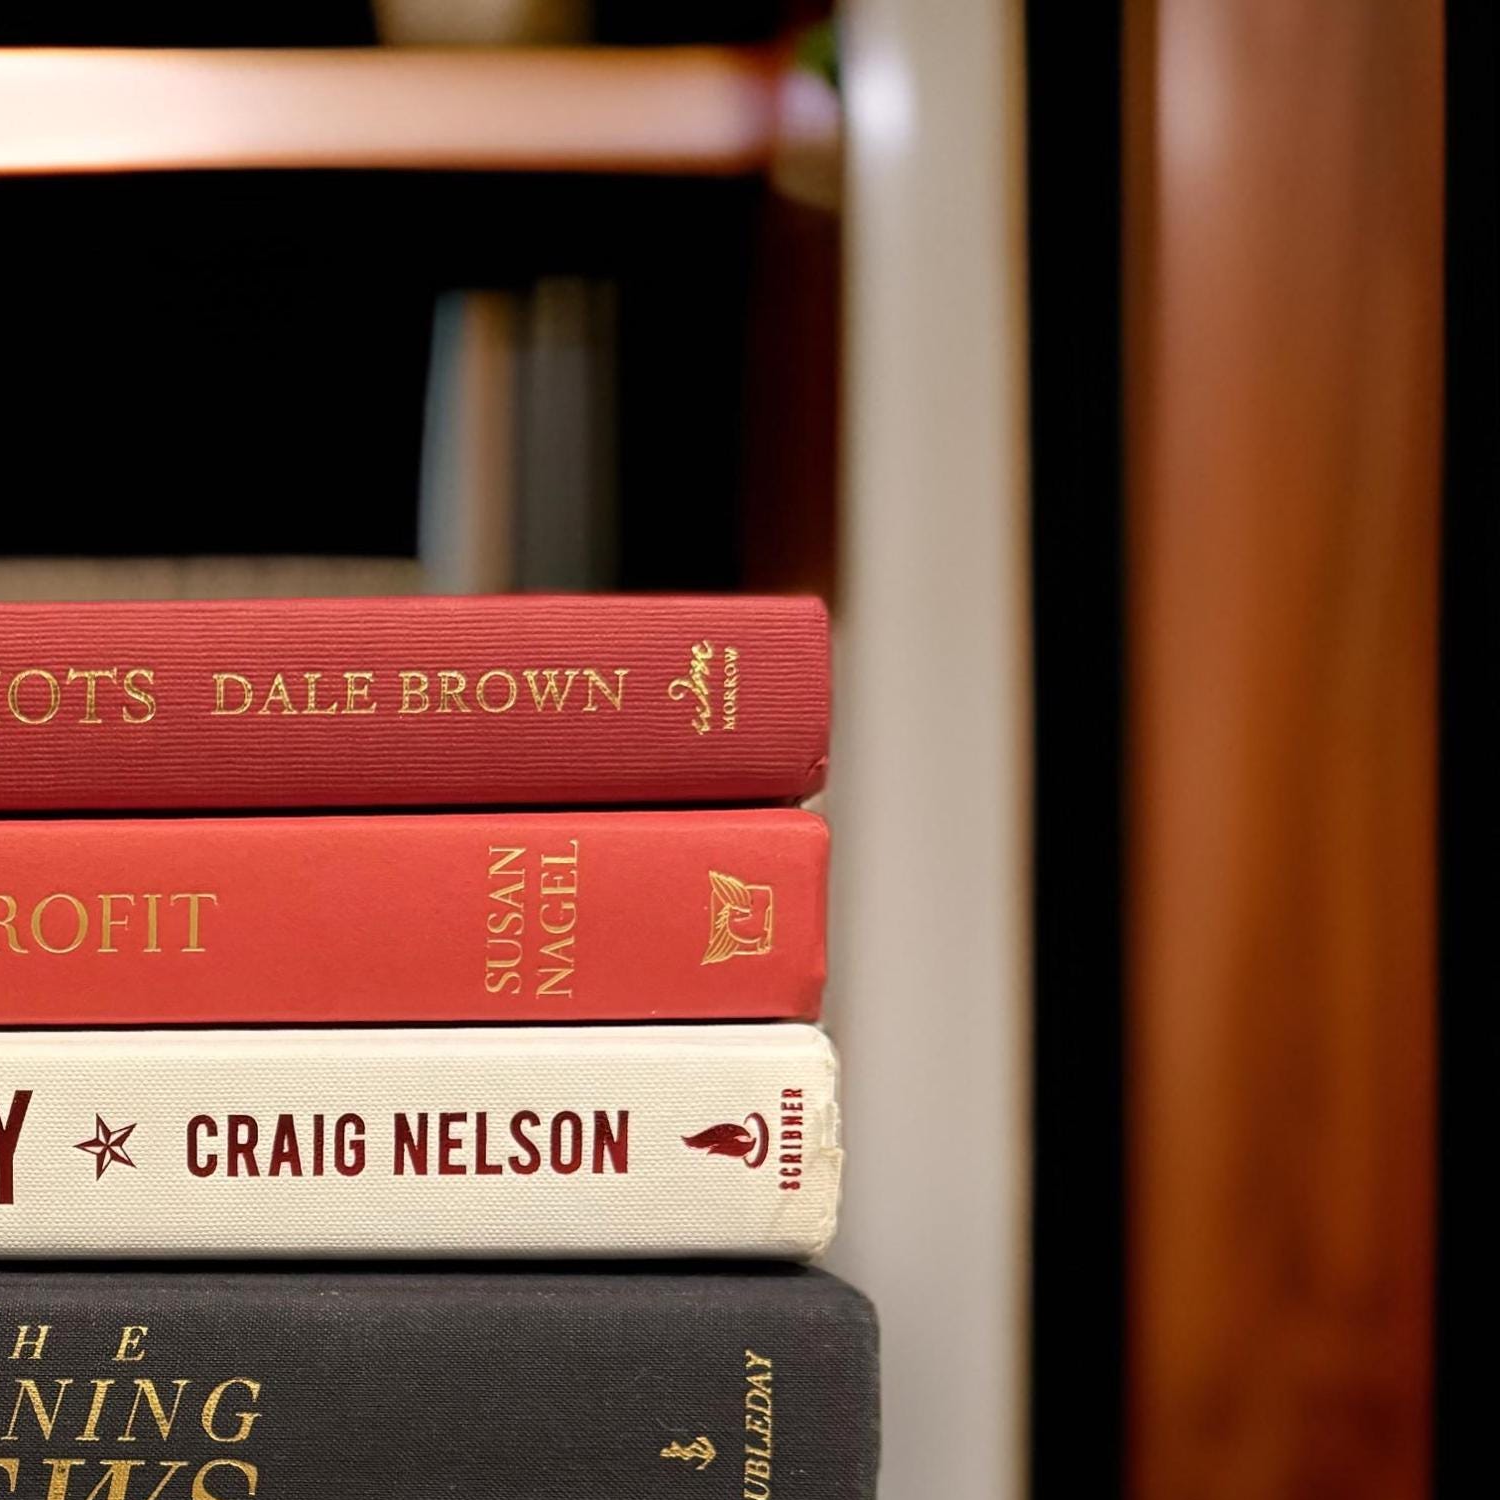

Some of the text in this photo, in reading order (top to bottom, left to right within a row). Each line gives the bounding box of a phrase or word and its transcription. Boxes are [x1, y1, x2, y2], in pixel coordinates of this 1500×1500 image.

[211, 667, 631, 717] DALE BROWN
[723, 646, 740, 730] MORROW
[485, 845, 527, 994] SUSAN
[536, 839, 579, 999] NAGEL
[186, 1109, 631, 1179] CRAIG NELSON
[779, 1087, 804, 1191] SCRIBNER
